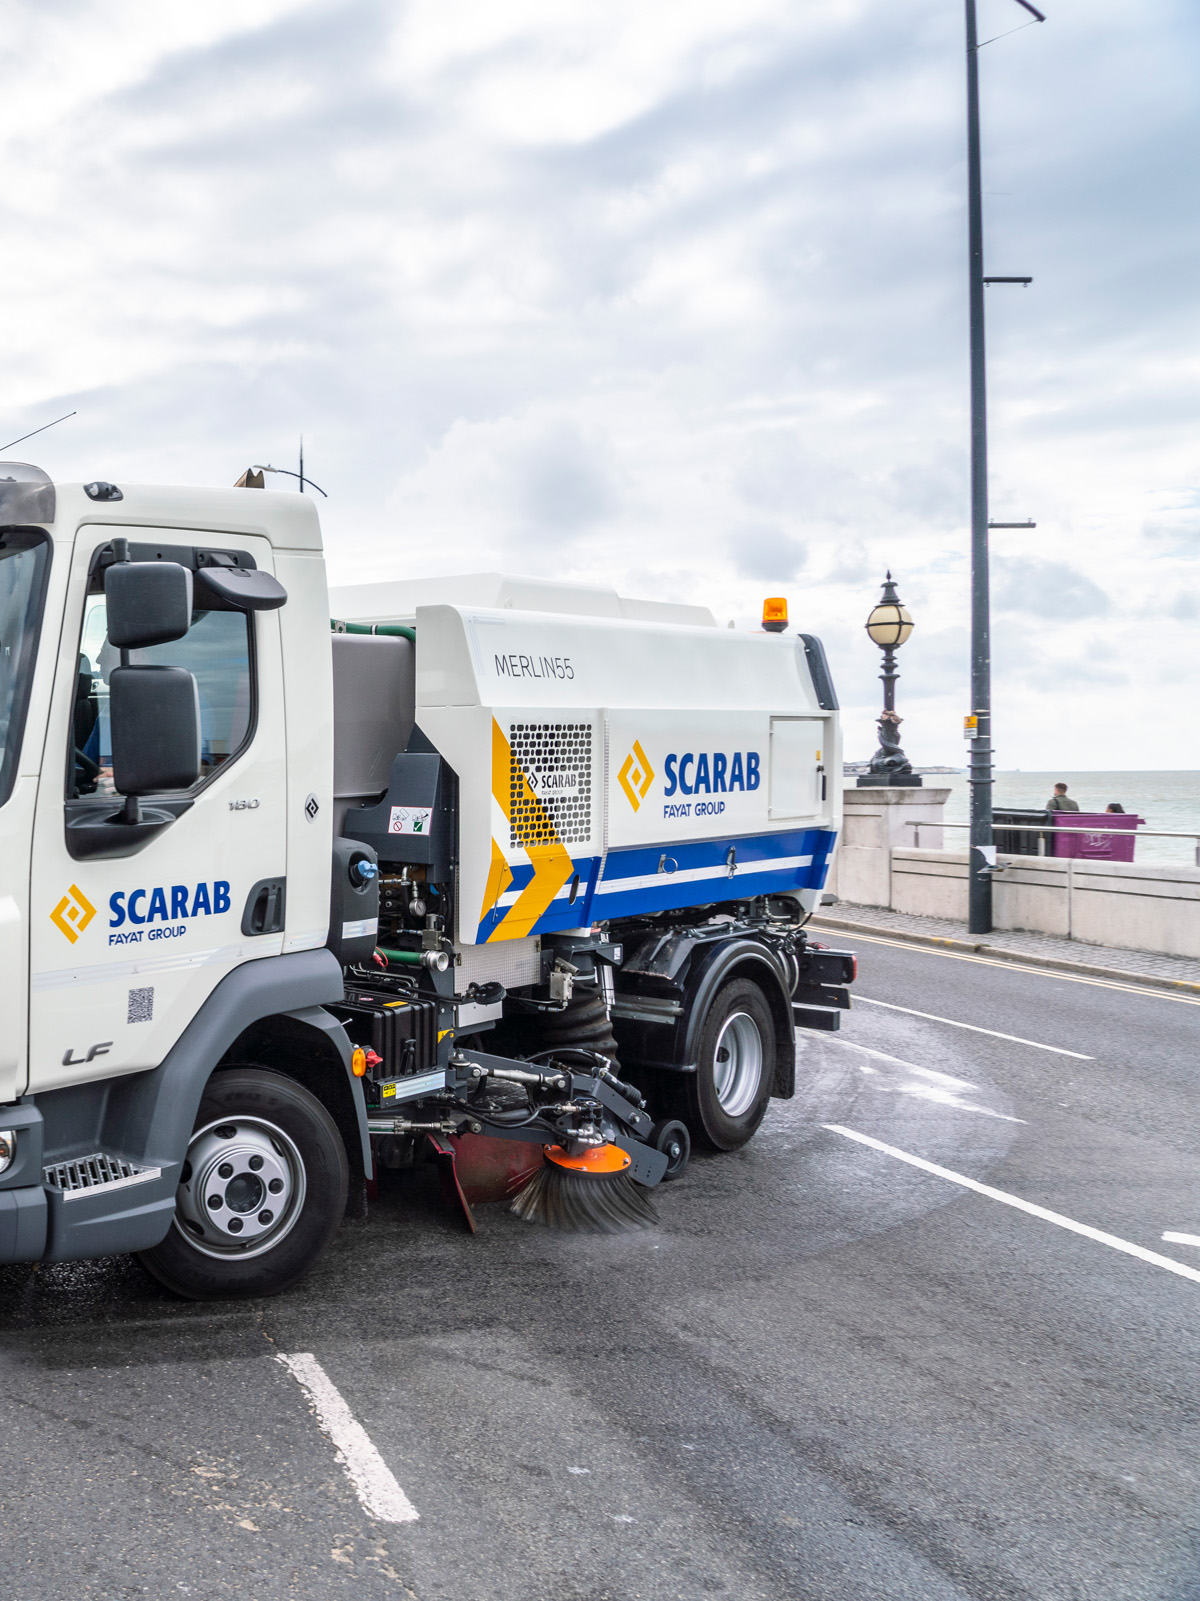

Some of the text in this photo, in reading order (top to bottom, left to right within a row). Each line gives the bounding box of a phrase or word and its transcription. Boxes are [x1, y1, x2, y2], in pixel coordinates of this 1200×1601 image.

[494, 654, 575, 680] MERLIN55
[541, 774, 577, 789] SCARAB
[663, 751, 761, 797] SCARAB
[663, 801, 726, 819] FAYAT GROUP
[108, 880, 232, 928] SCARAB
[108, 925, 187, 946] FAYAT GROUP
[61, 1041, 114, 1066] LF
